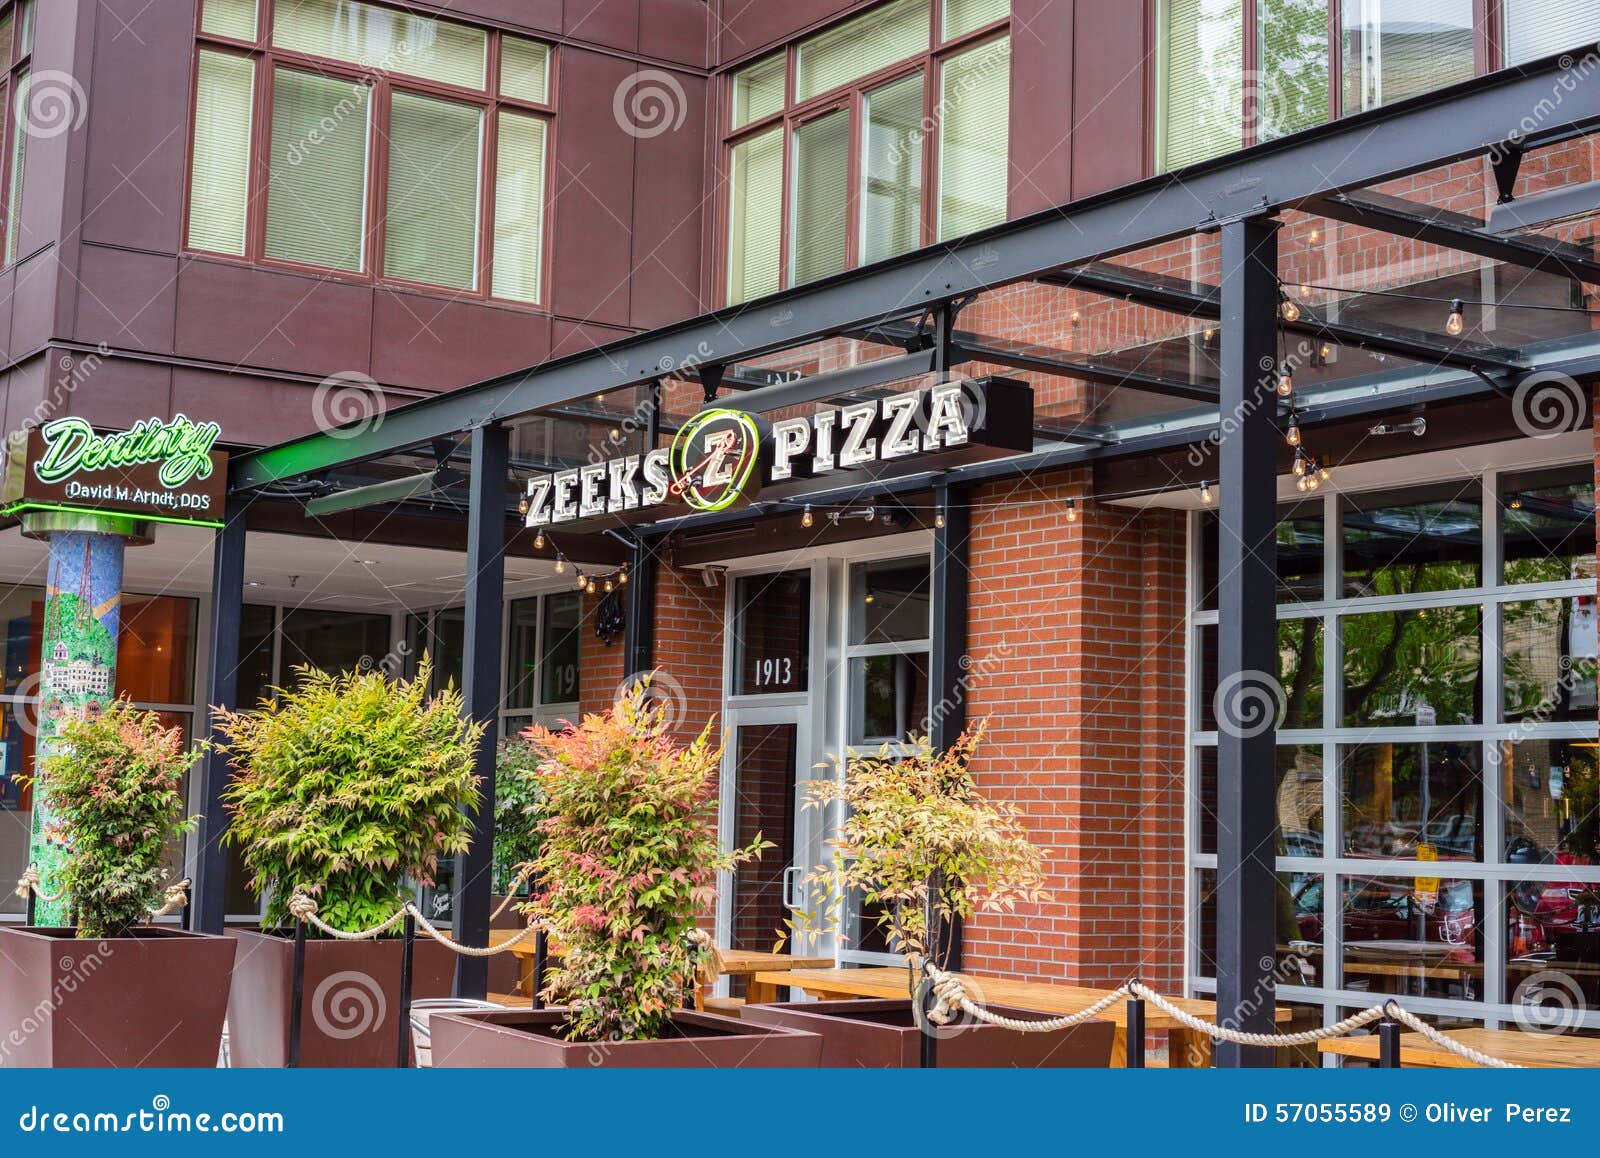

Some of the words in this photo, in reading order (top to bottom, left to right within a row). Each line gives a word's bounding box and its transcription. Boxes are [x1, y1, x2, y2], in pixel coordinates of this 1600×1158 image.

[33, 412, 222, 489] Dentistry
[525, 447, 671, 528] ZEEKS
[772, 380, 969, 481] PIZZA
[66, 481, 112, 499] David
[133, 488, 177, 510] Arndt,
[180, 493, 211, 510] DDS
[755, 657, 792, 686] 1913
